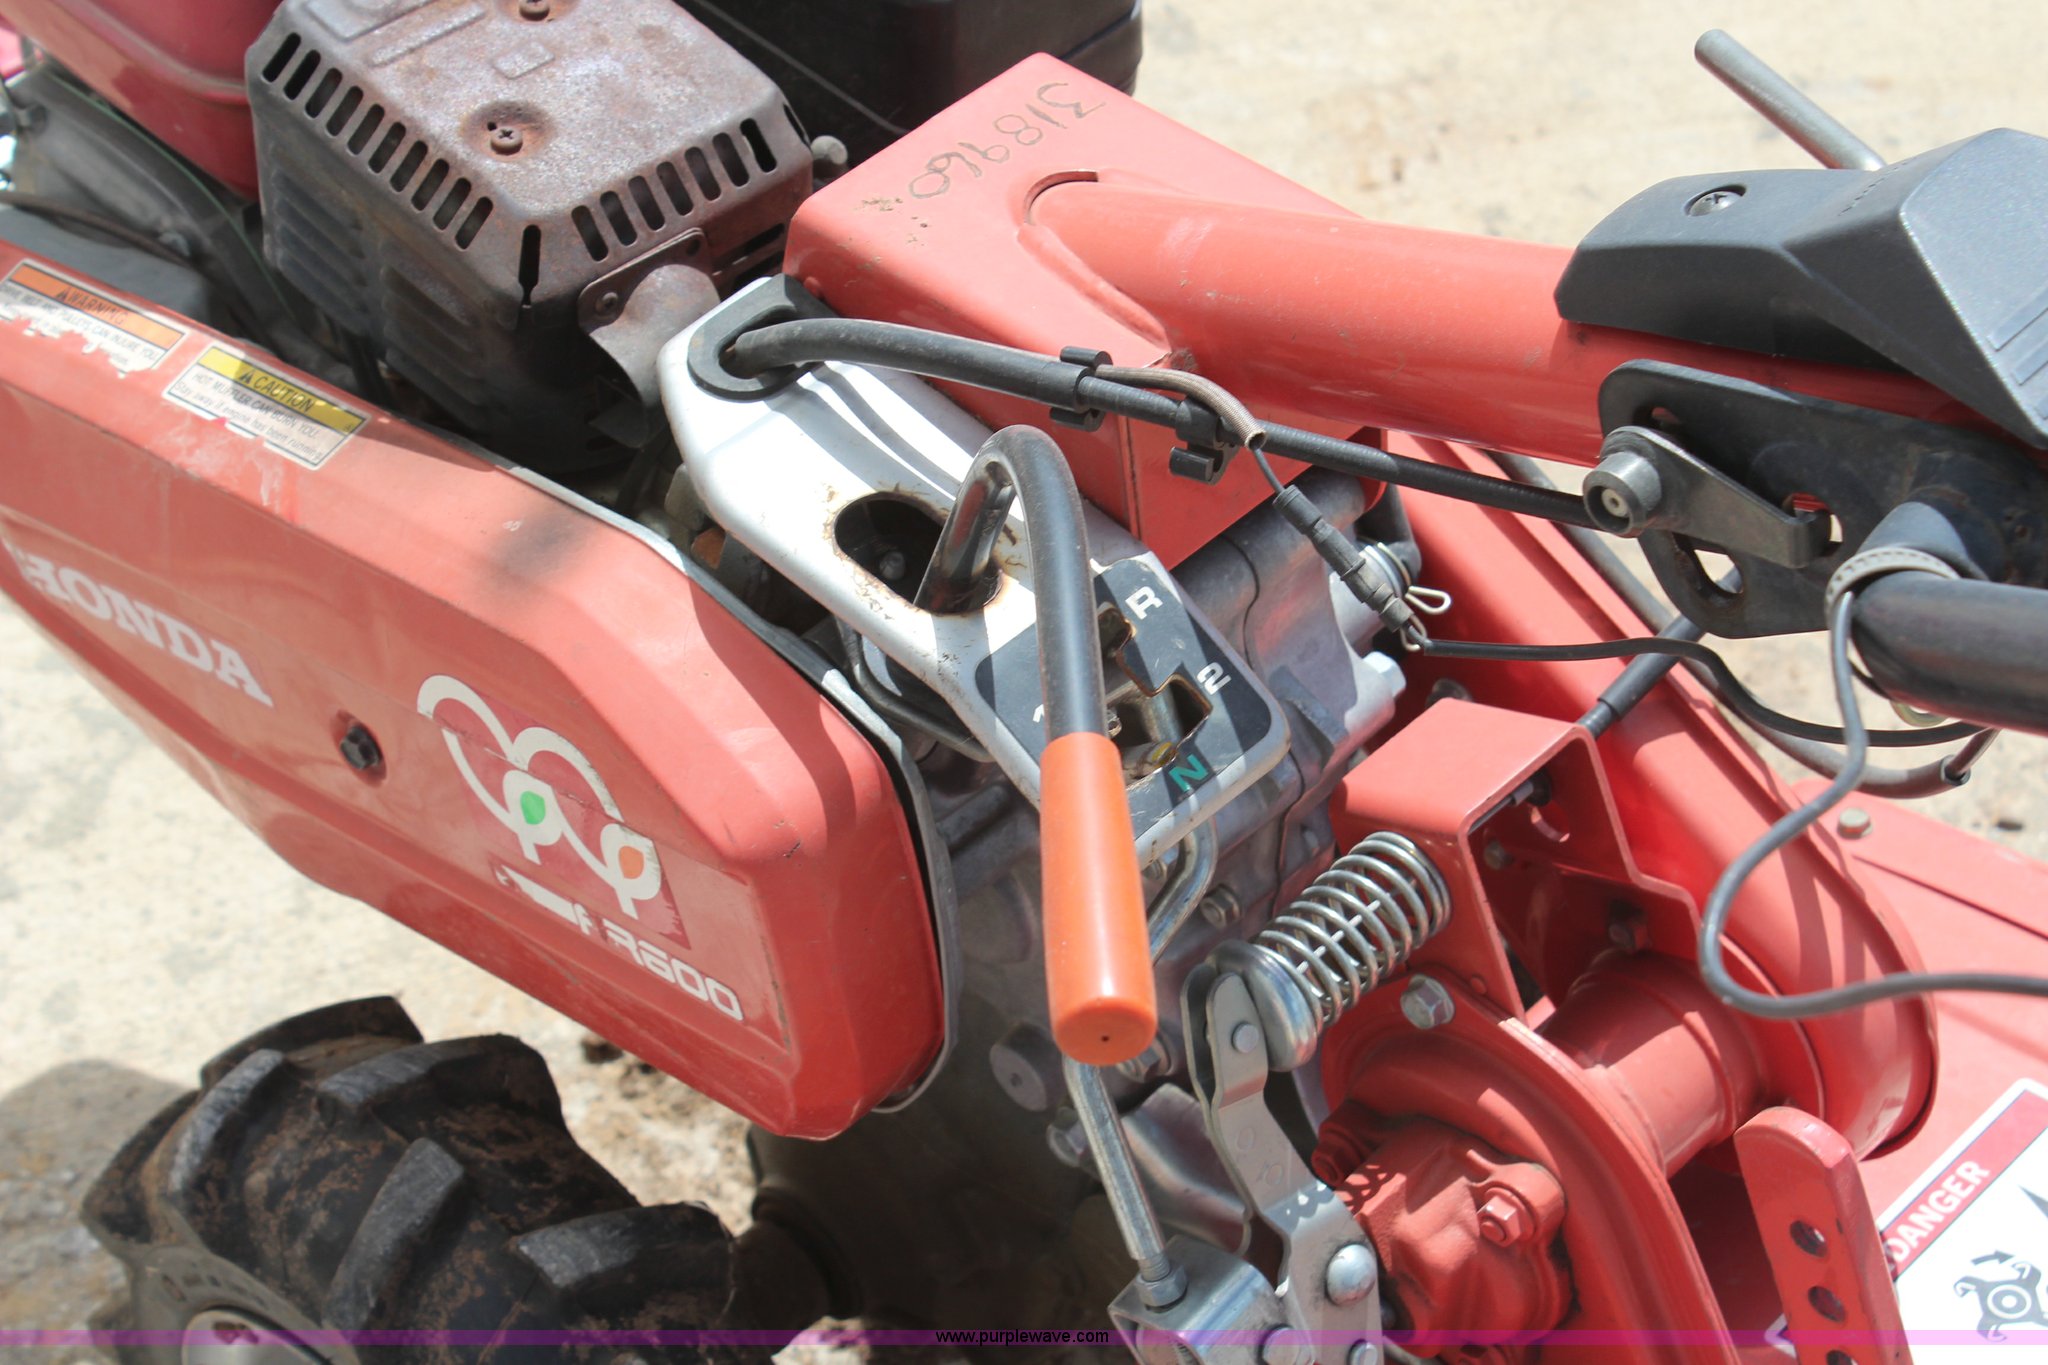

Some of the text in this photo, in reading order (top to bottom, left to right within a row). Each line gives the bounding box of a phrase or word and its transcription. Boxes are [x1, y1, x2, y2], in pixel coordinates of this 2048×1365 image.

[65, 286, 128, 325] WARNING
[253, 375, 315, 413] CAUTION
[1125, 586, 1163, 620] R
[1197, 661, 1231, 695] 2
[1169, 754, 1208, 793] N
